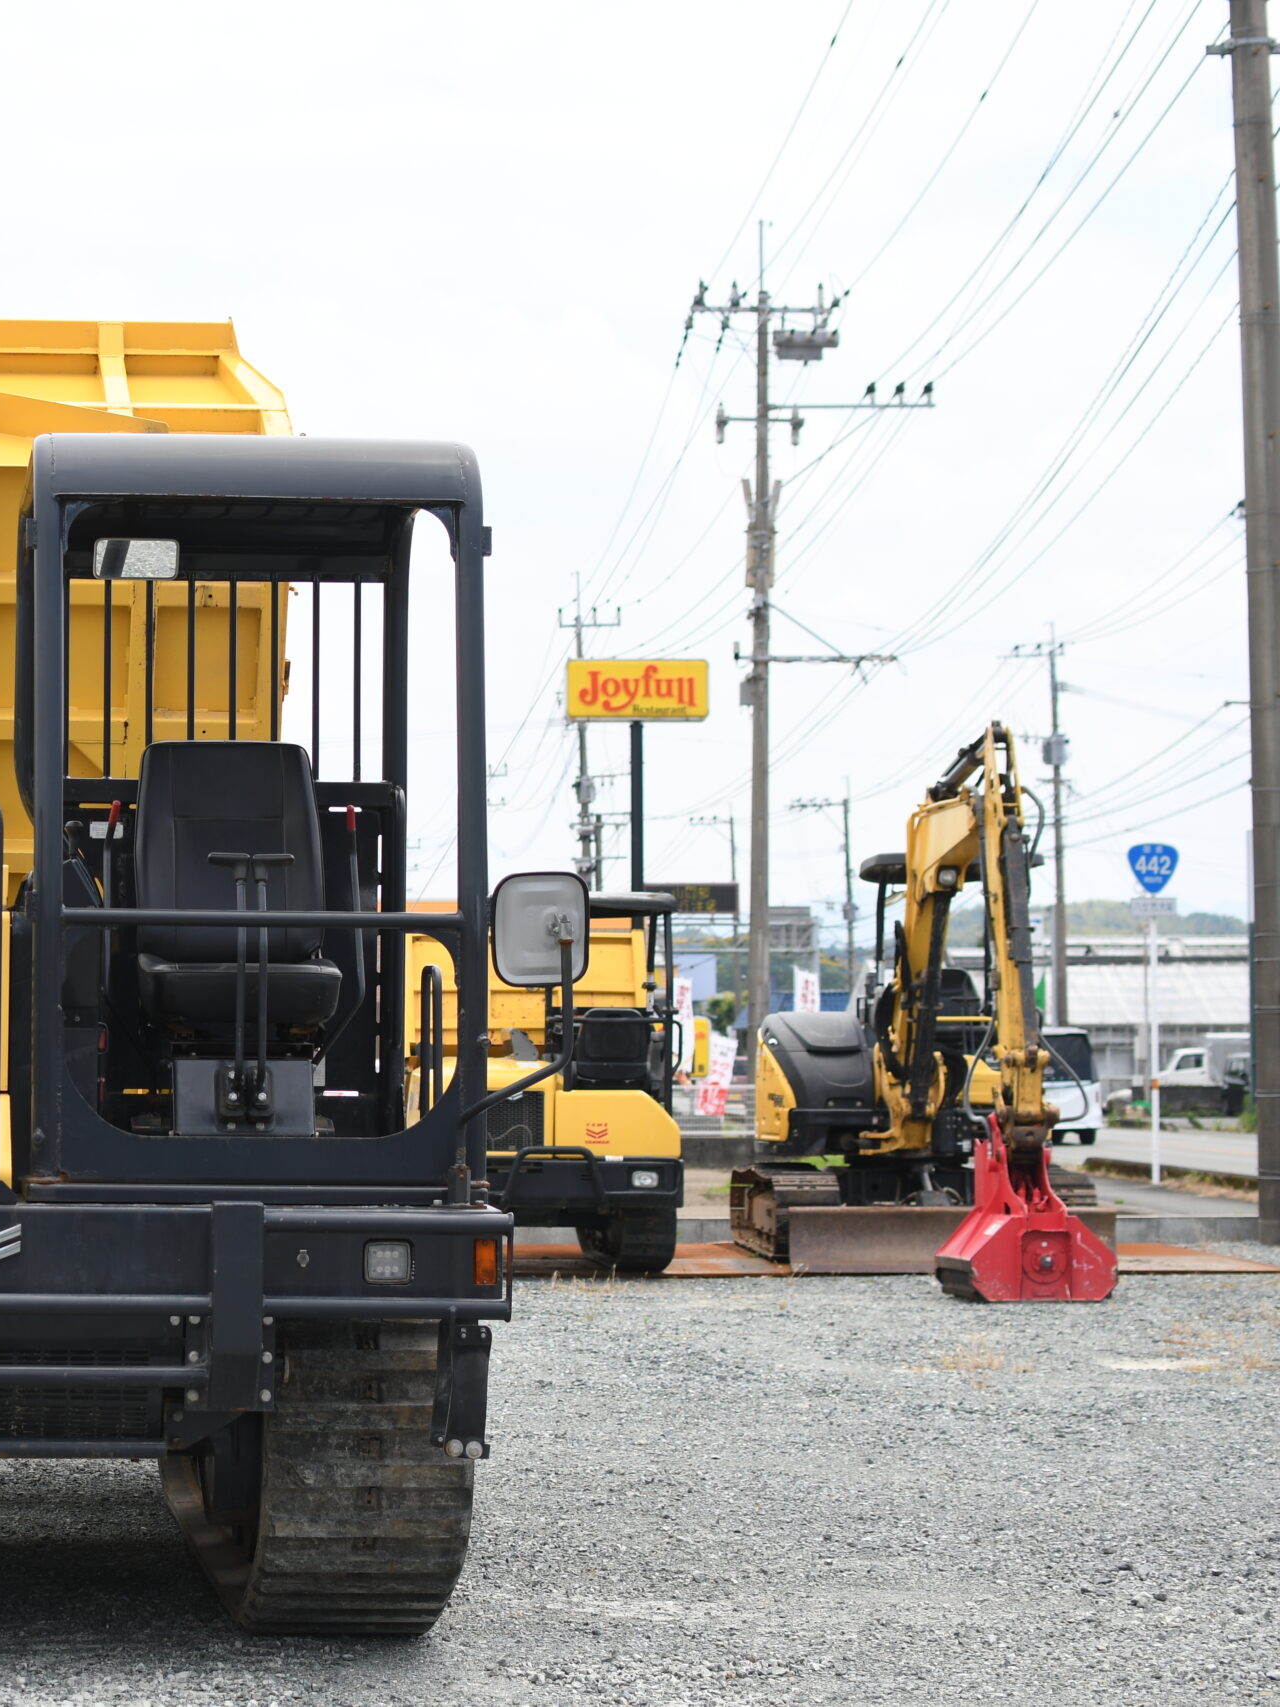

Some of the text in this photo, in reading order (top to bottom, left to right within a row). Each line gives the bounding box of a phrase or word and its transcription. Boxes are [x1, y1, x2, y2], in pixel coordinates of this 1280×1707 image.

[578, 664, 697, 712] Joyfull
[632, 703, 688, 714] Restaurant
[1135, 855, 1172, 875] 442
